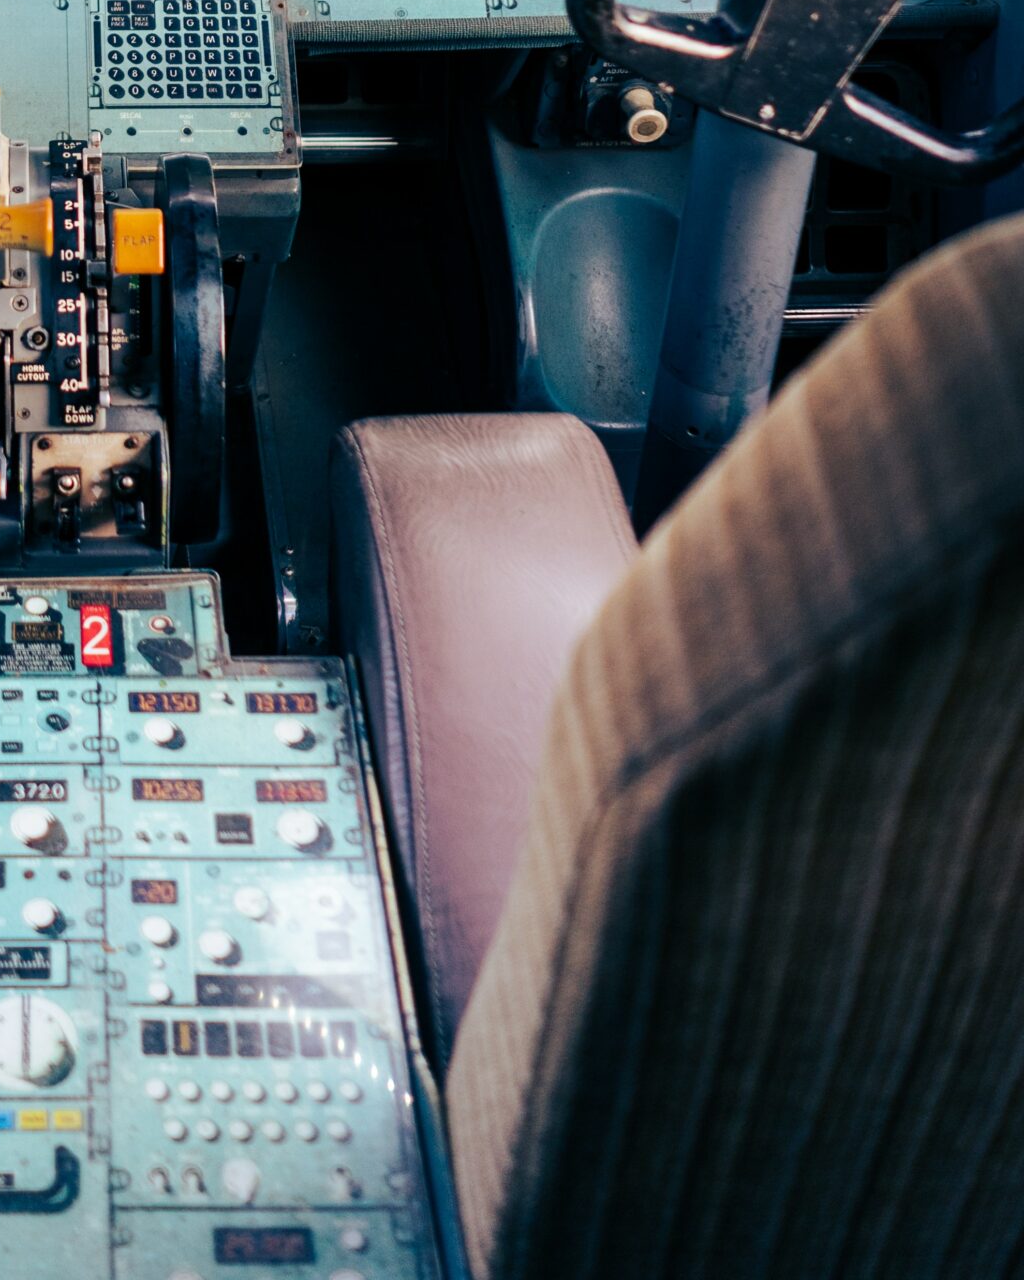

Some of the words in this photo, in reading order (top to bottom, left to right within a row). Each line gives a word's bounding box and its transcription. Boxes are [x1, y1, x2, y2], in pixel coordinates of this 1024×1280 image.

[65, 220, 73, 230] 5
[124, 236, 155, 245] FLAP
[61, 250, 74, 260] 10
[62, 271, 74, 282] 15
[58, 300, 75, 312] 25
[57, 334, 75, 346] 30
[61, 380, 78, 391] 40
[66, 405, 92, 413] FLAP
[65, 415, 93, 423] DOWN
[83, 616, 110, 655] 2
[139, 695, 197, 712] 121.50
